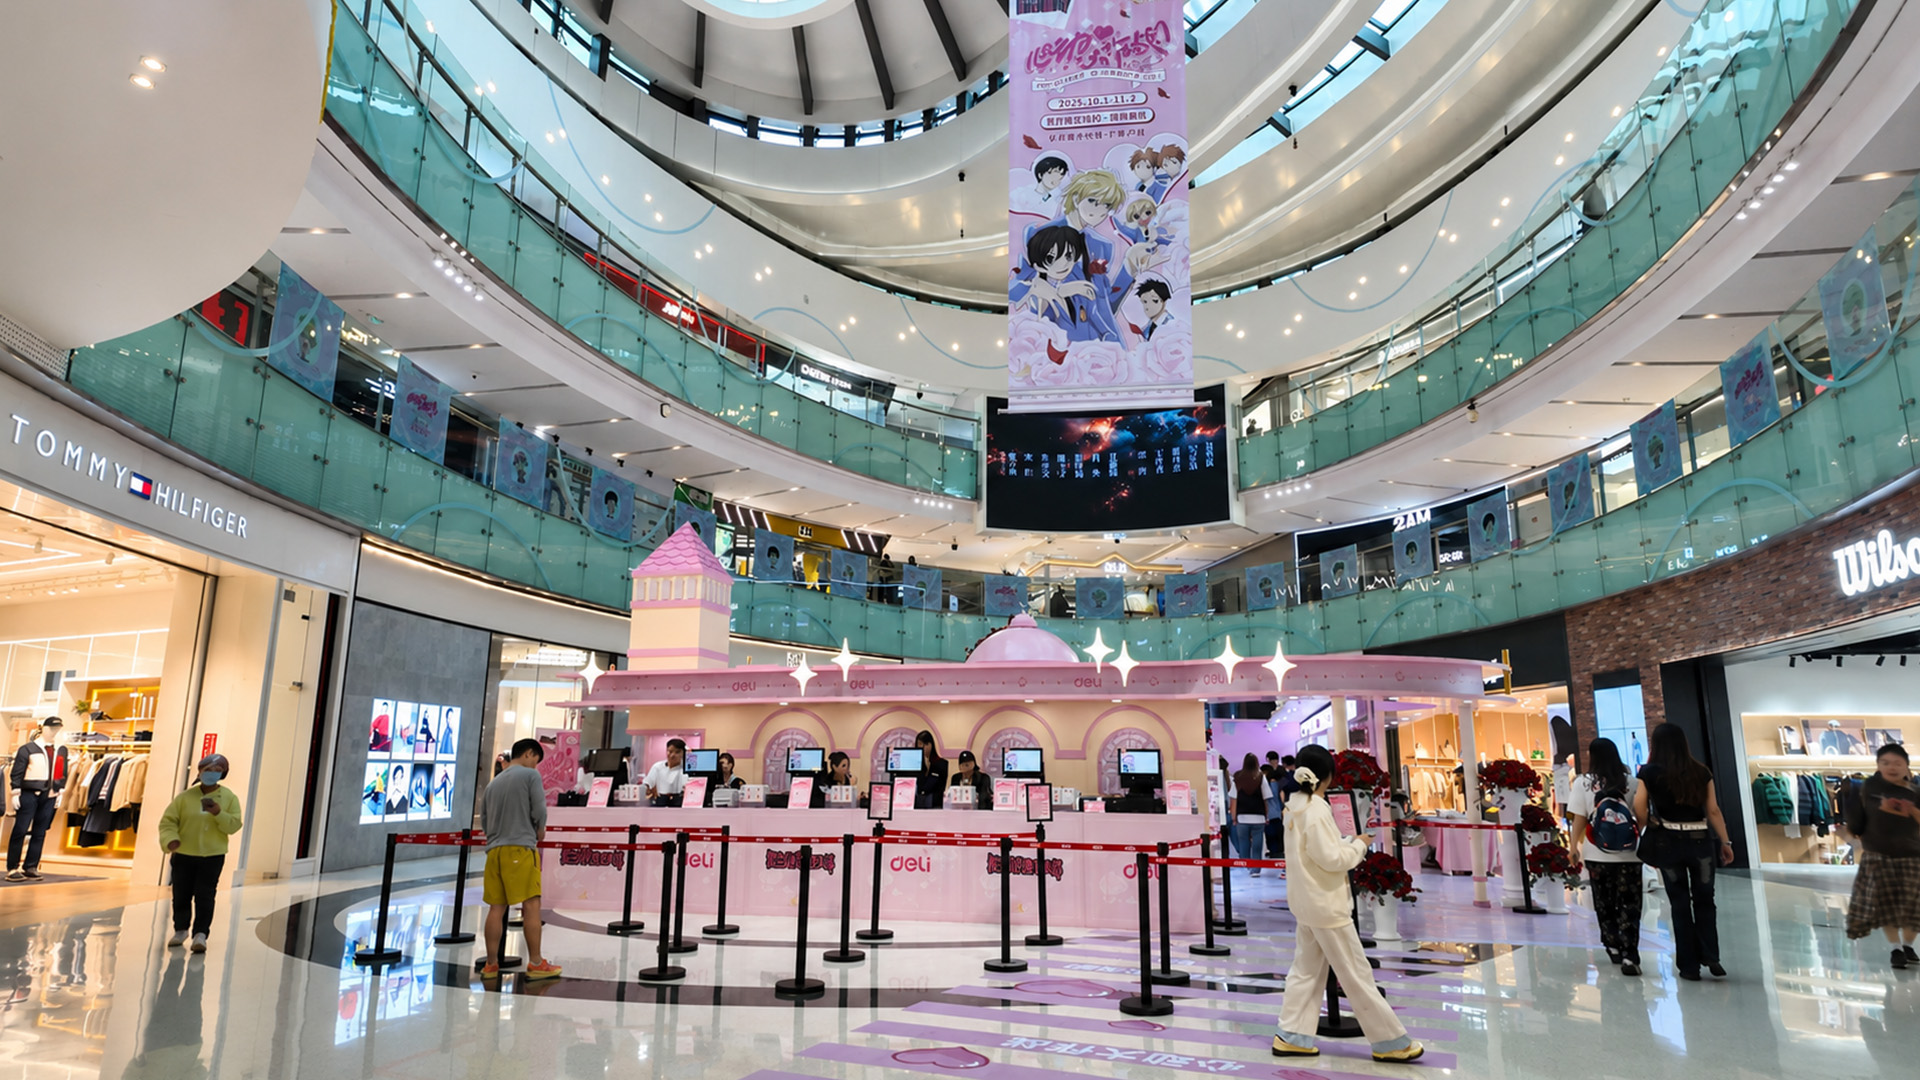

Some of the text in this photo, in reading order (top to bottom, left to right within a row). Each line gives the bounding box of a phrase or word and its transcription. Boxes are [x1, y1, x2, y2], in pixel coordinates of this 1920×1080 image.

[11, 414, 248, 539] TOMMY HILFIGER
[1393, 509, 1431, 532] 2AM
[890, 856, 931, 873] deli
